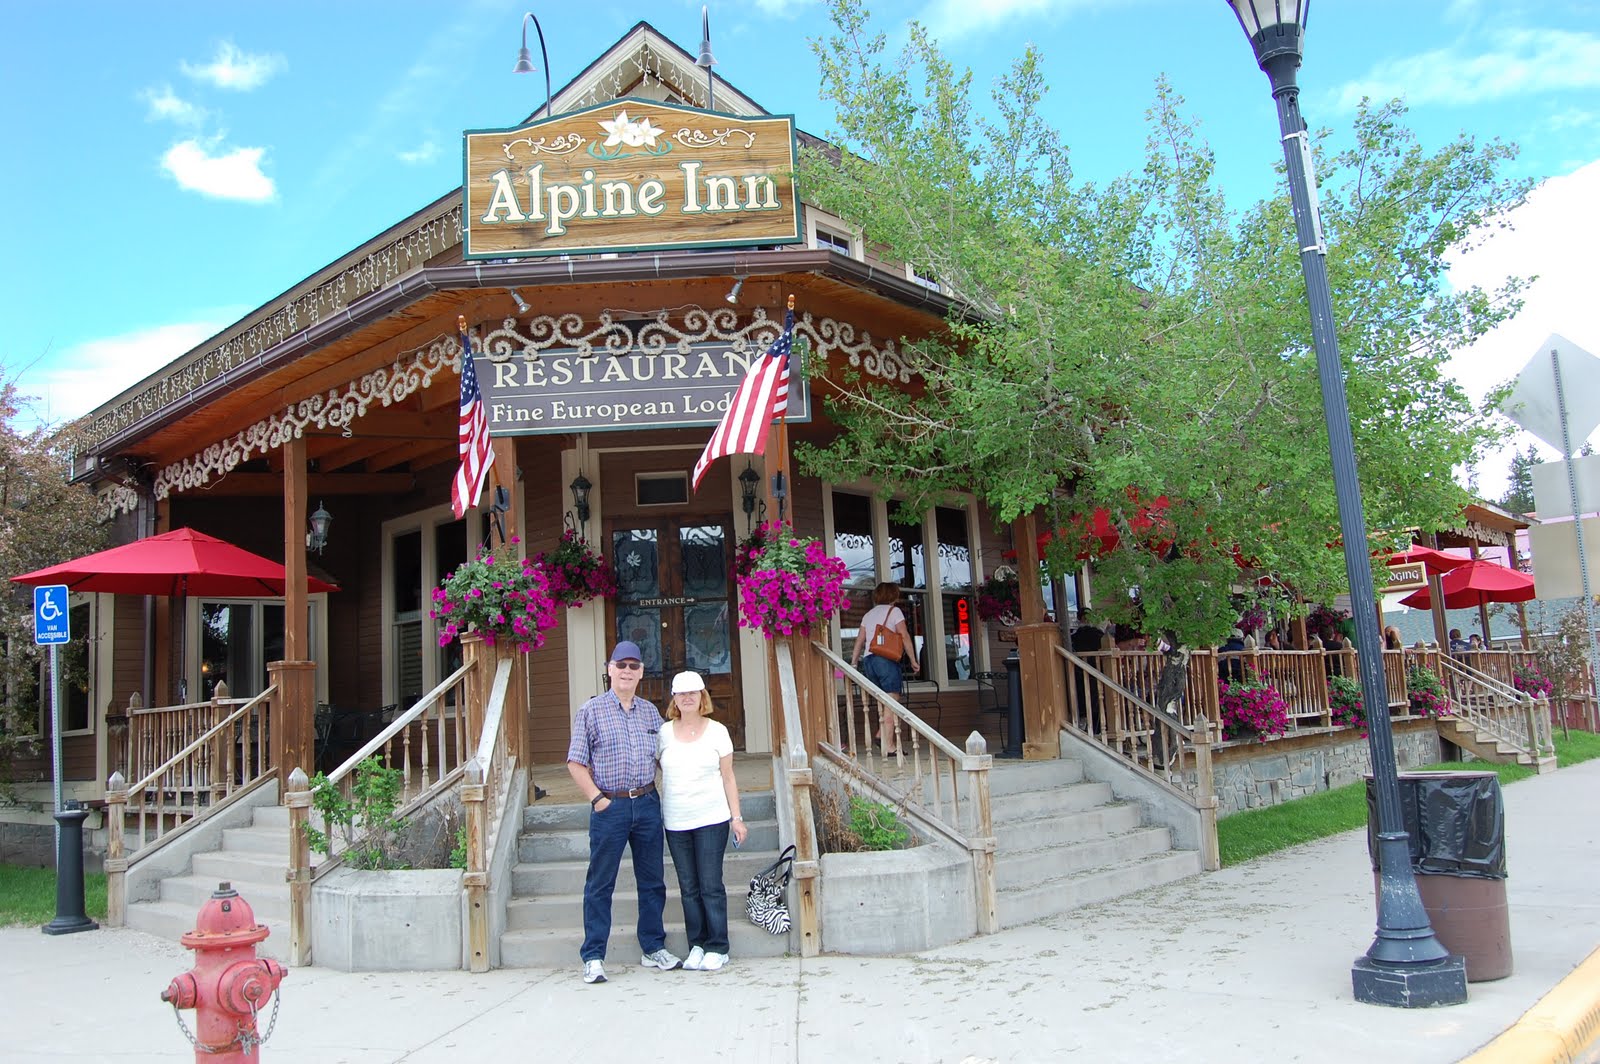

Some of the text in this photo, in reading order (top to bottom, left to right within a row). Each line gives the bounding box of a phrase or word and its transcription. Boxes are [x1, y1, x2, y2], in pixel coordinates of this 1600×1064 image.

[481, 160, 781, 235] Alpine Inn
[492, 351, 767, 388] RESTAURAN
[491, 403, 544, 423] Fine
[551, 400, 675, 421] European
[640, 597, 686, 606] ENTRANCE
[38, 631, 67, 640] ACCESSIBLE
